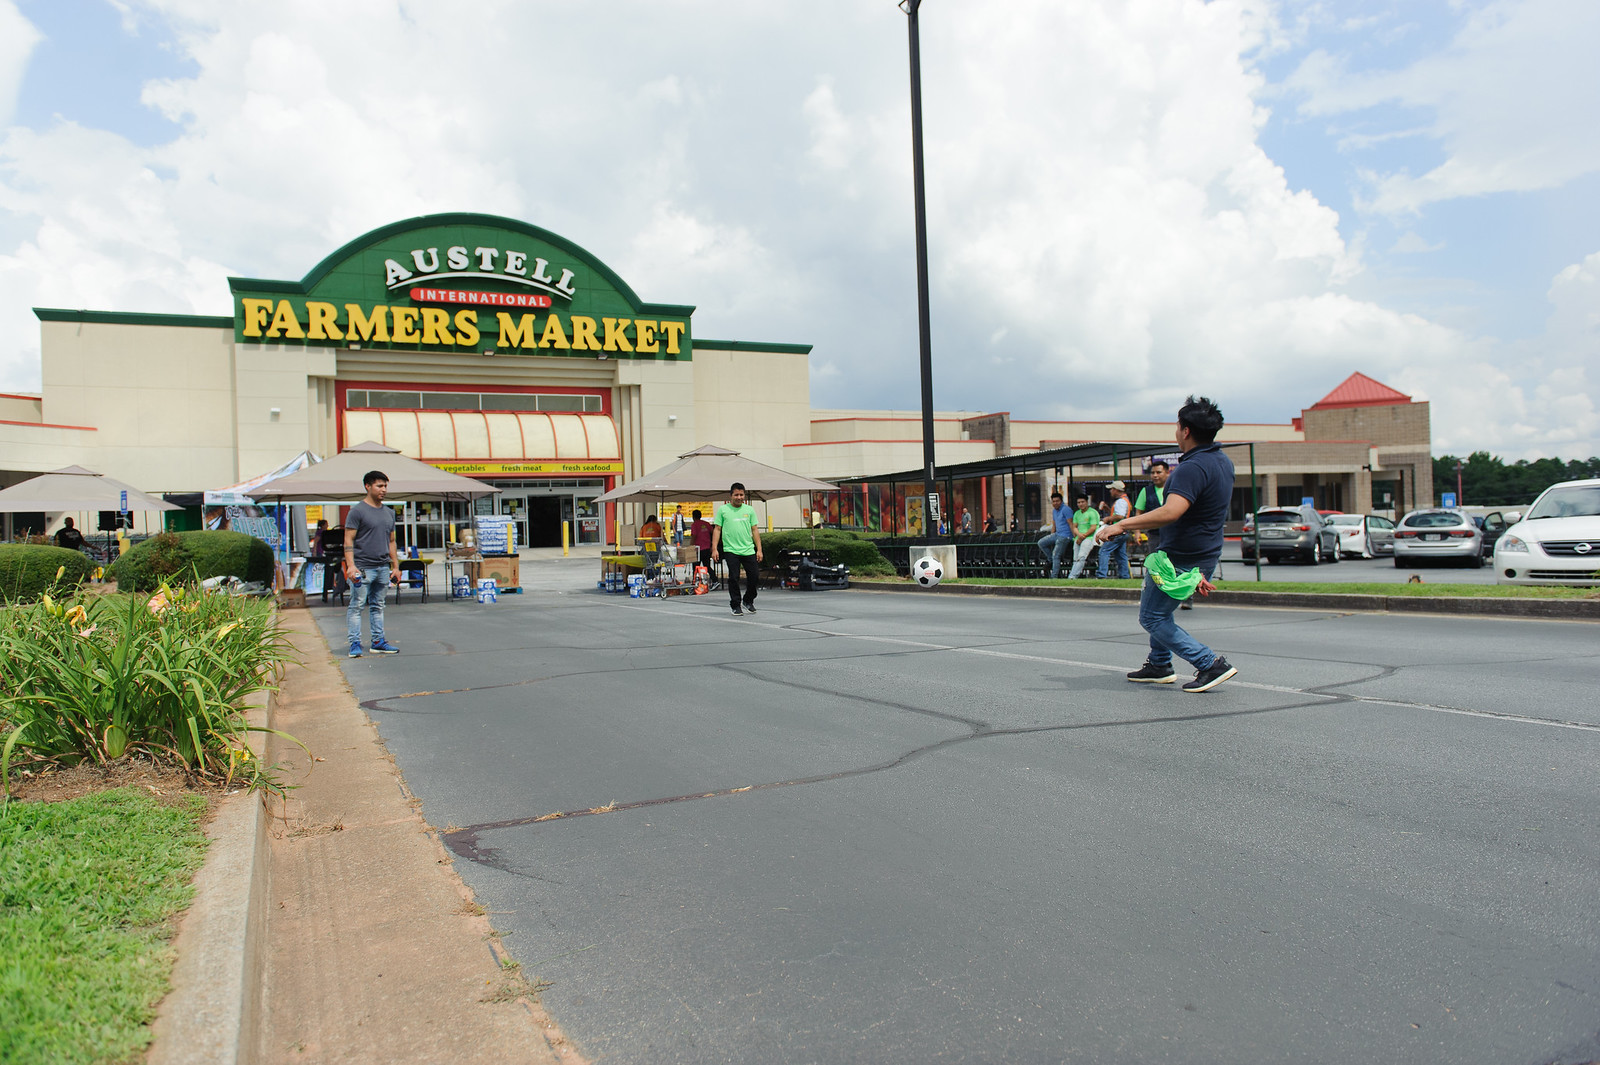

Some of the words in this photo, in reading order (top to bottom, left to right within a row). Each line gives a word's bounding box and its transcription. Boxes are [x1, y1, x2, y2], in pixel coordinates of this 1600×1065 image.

[384, 246, 576, 295] AUSTELL
[419, 289, 547, 307] INTERNATIONAL
[242, 298, 481, 347] FARMERS
[496, 312, 686, 356] MARKET
[443, 462, 486, 474] vegetables
[501, 462, 521, 472] fresh
[523, 463, 542, 472] meat
[562, 463, 581, 472] fresh
[582, 463, 611, 472] seafood
